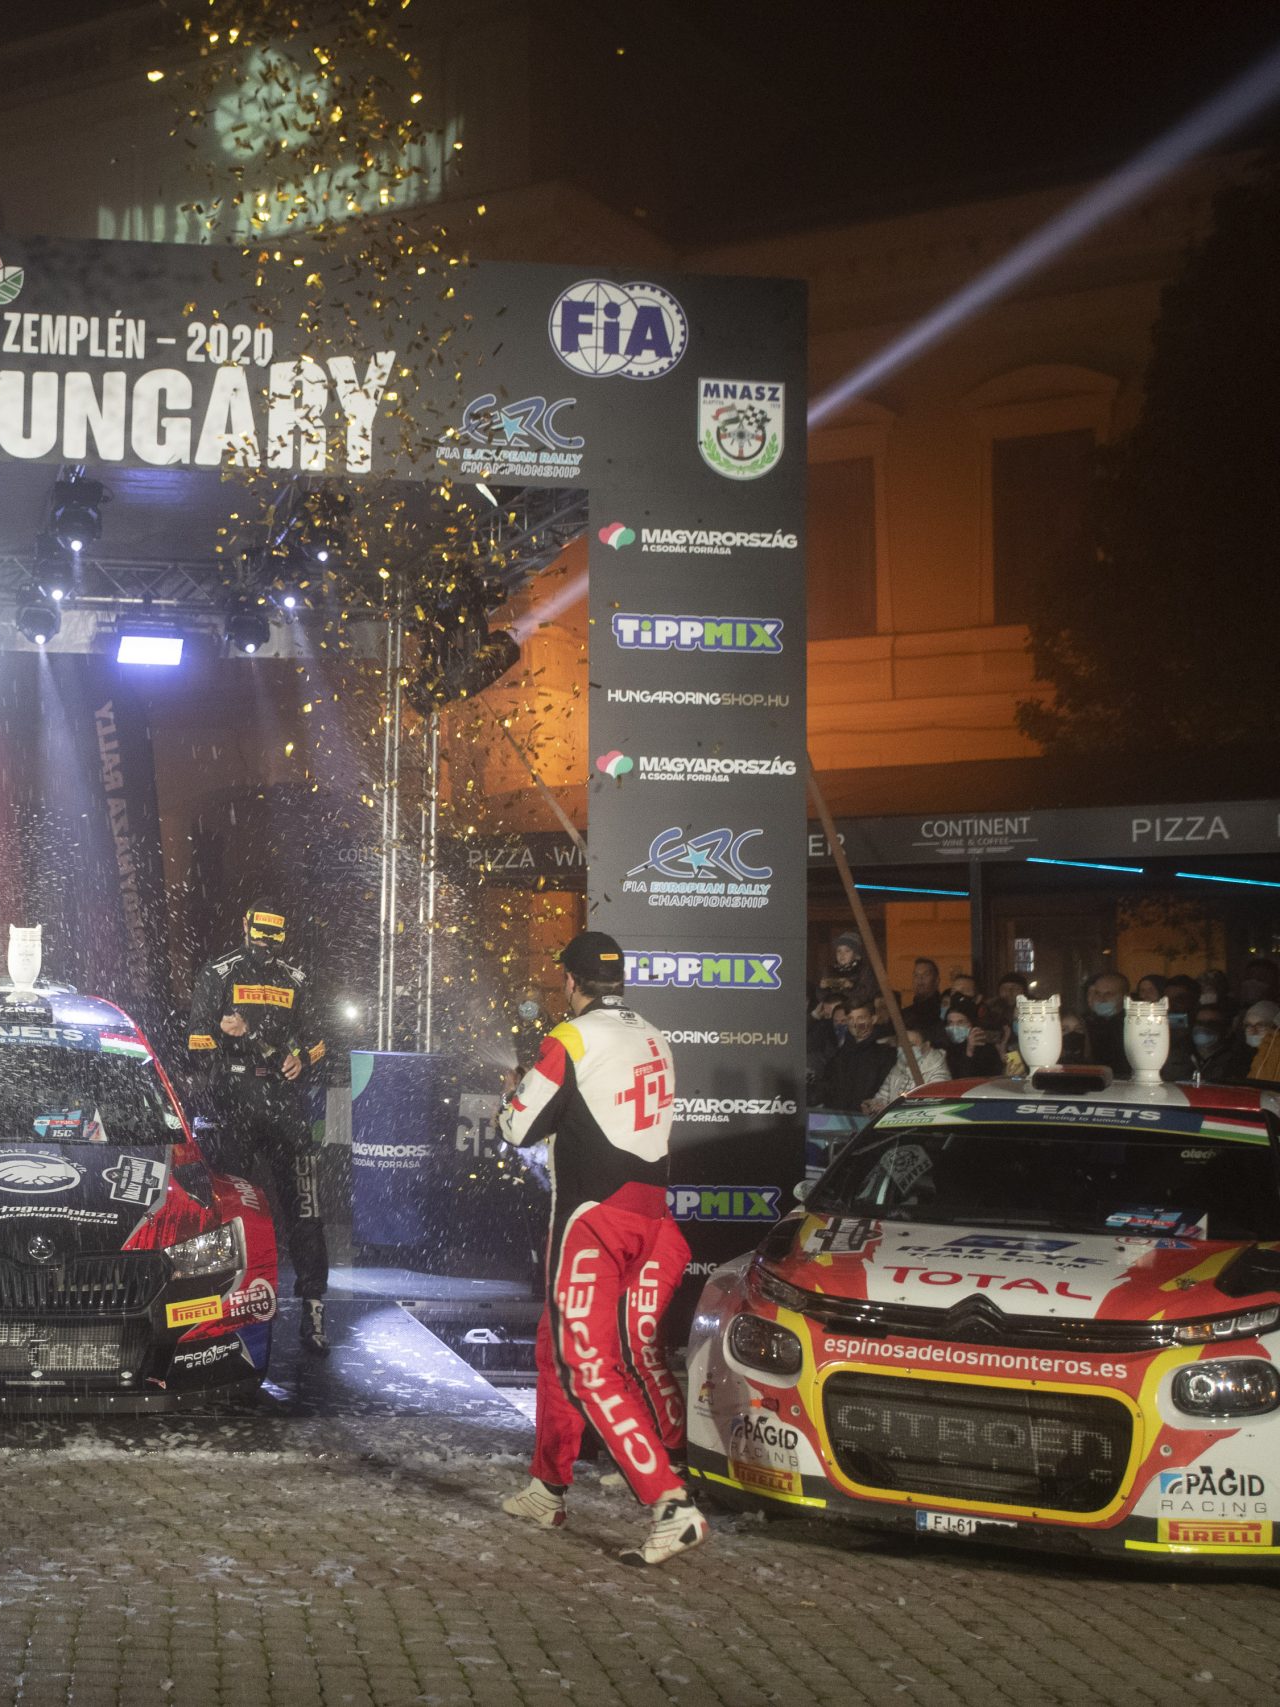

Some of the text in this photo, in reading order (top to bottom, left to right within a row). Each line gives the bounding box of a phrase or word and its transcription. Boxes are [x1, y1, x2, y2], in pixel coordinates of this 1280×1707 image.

[2, 311, 146, 360] ZEMPLÉN
[186, 320, 274, 368] 2020
[703, 383, 780, 401] MNASZ
[436, 446, 461, 459] FIA
[540, 452, 583, 466] RALLY
[461, 461, 581, 478] CHAMPIONSHIP
[642, 528, 797, 549] MAGYARORSZÁG
[650, 545, 687, 554] CSODÁK
[689, 545, 732, 555] FORRÁSA
[607, 689, 789, 707] HUNGARORINGSHOP.HU
[640, 756, 796, 776] MAGYARORSZÁG
[648, 773, 685, 782] CSODÁK
[687, 774, 730, 783] FORRÁSA
[921, 817, 1031, 839] CONTINENT
[1132, 815, 1230, 843] PIZZA
[977, 838, 1009, 846] COFFEE
[468, 847, 535, 868] PIZZA
[623, 880, 771, 896] FIA EUROPEAN RALLY
[648, 894, 769, 909] CHAMPIONSHIP
[238, 987, 290, 1005] PIRELLI
[686, 1114, 729, 1122] FORRÁSA
[1015, 1104, 1161, 1121] SEAJETS
[352, 1158, 420, 1169] SODÁK FORRÁSA
[883, 1266, 1093, 1300] TOTAL
[172, 1301, 218, 1322] PIRELLI
[231, 1301, 269, 1317] ELECTRO
[631, 1260, 683, 1426] CITROËN
[28, 1344, 120, 1370] CARS
[559, 1249, 657, 1474] CITROËN
[823, 1336, 1128, 1379] espinosadelosmonteros.es
[745, 1421, 798, 1450] PAGID
[734, 1462, 794, 1492] PIRELLI
[1186, 1473, 1265, 1496] PAGID
[1161, 1500, 1267, 1513] RACING
[1168, 1521, 1262, 1543] PIRELLI
